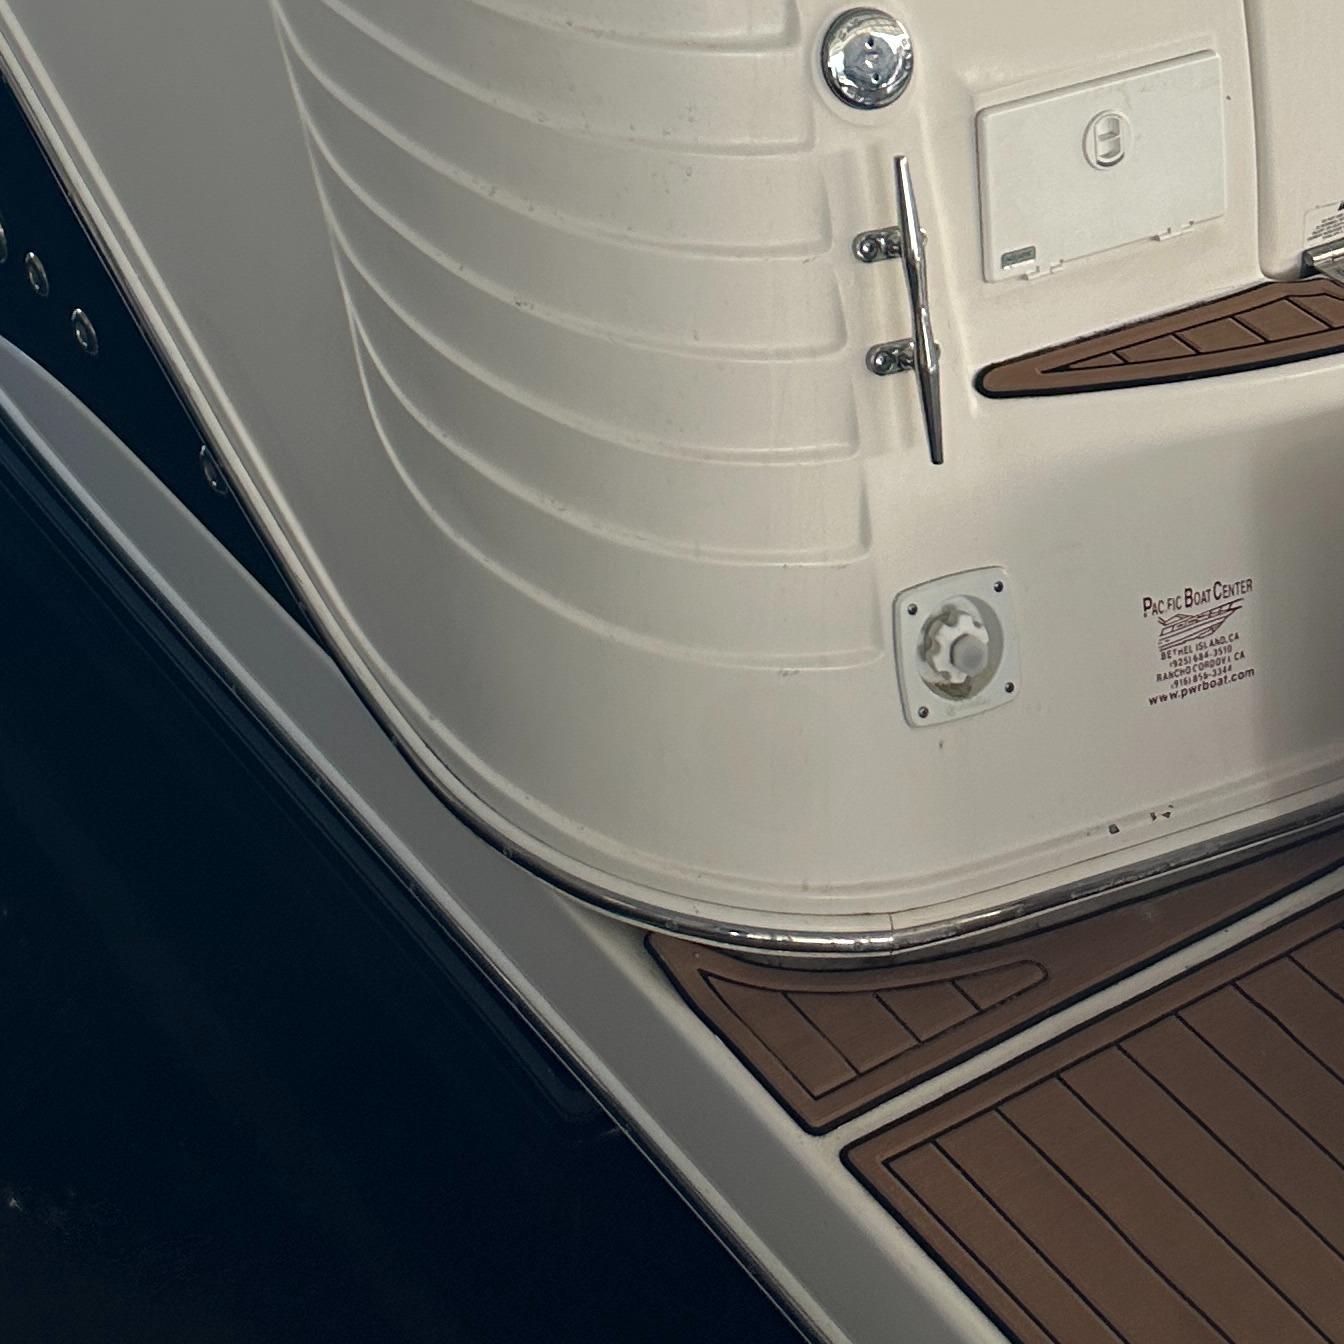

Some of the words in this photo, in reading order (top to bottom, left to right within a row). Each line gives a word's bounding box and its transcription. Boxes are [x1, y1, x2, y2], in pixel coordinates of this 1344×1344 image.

[1143, 596, 1182, 617] PACFIC
[1161, 645, 1193, 660] BETHEL
[1156, 666, 1191, 682] RANCHO
[1149, 668, 1255, 705] www.pwrboat.com
